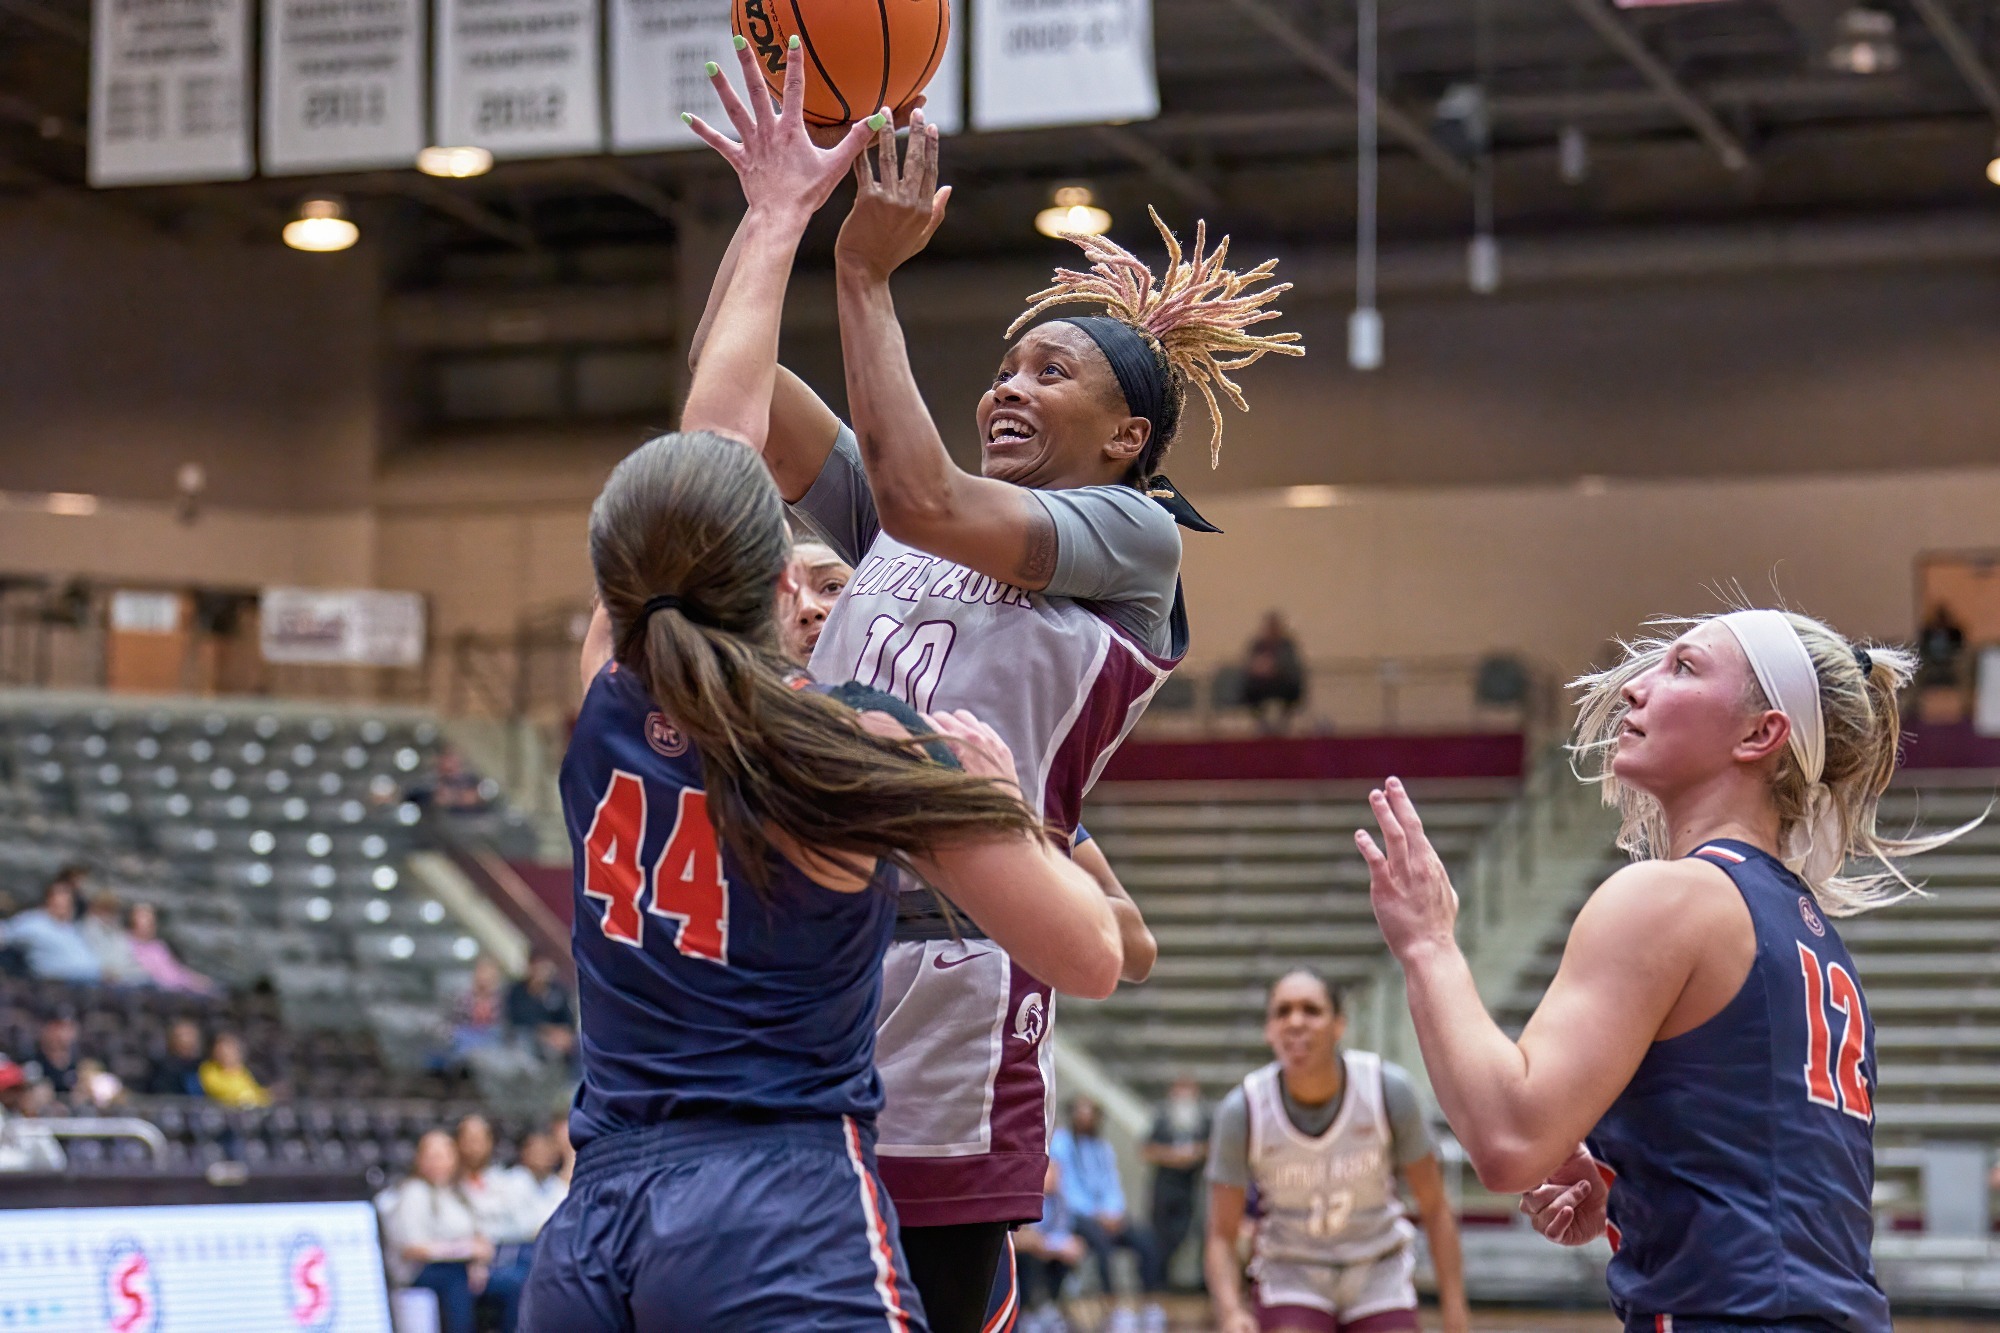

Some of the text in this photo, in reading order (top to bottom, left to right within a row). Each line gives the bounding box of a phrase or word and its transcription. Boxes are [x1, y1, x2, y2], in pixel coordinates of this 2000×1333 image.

[853, 613, 957, 714] 10
[583, 768, 729, 966] 44
[1796, 939, 1873, 1125] 12
